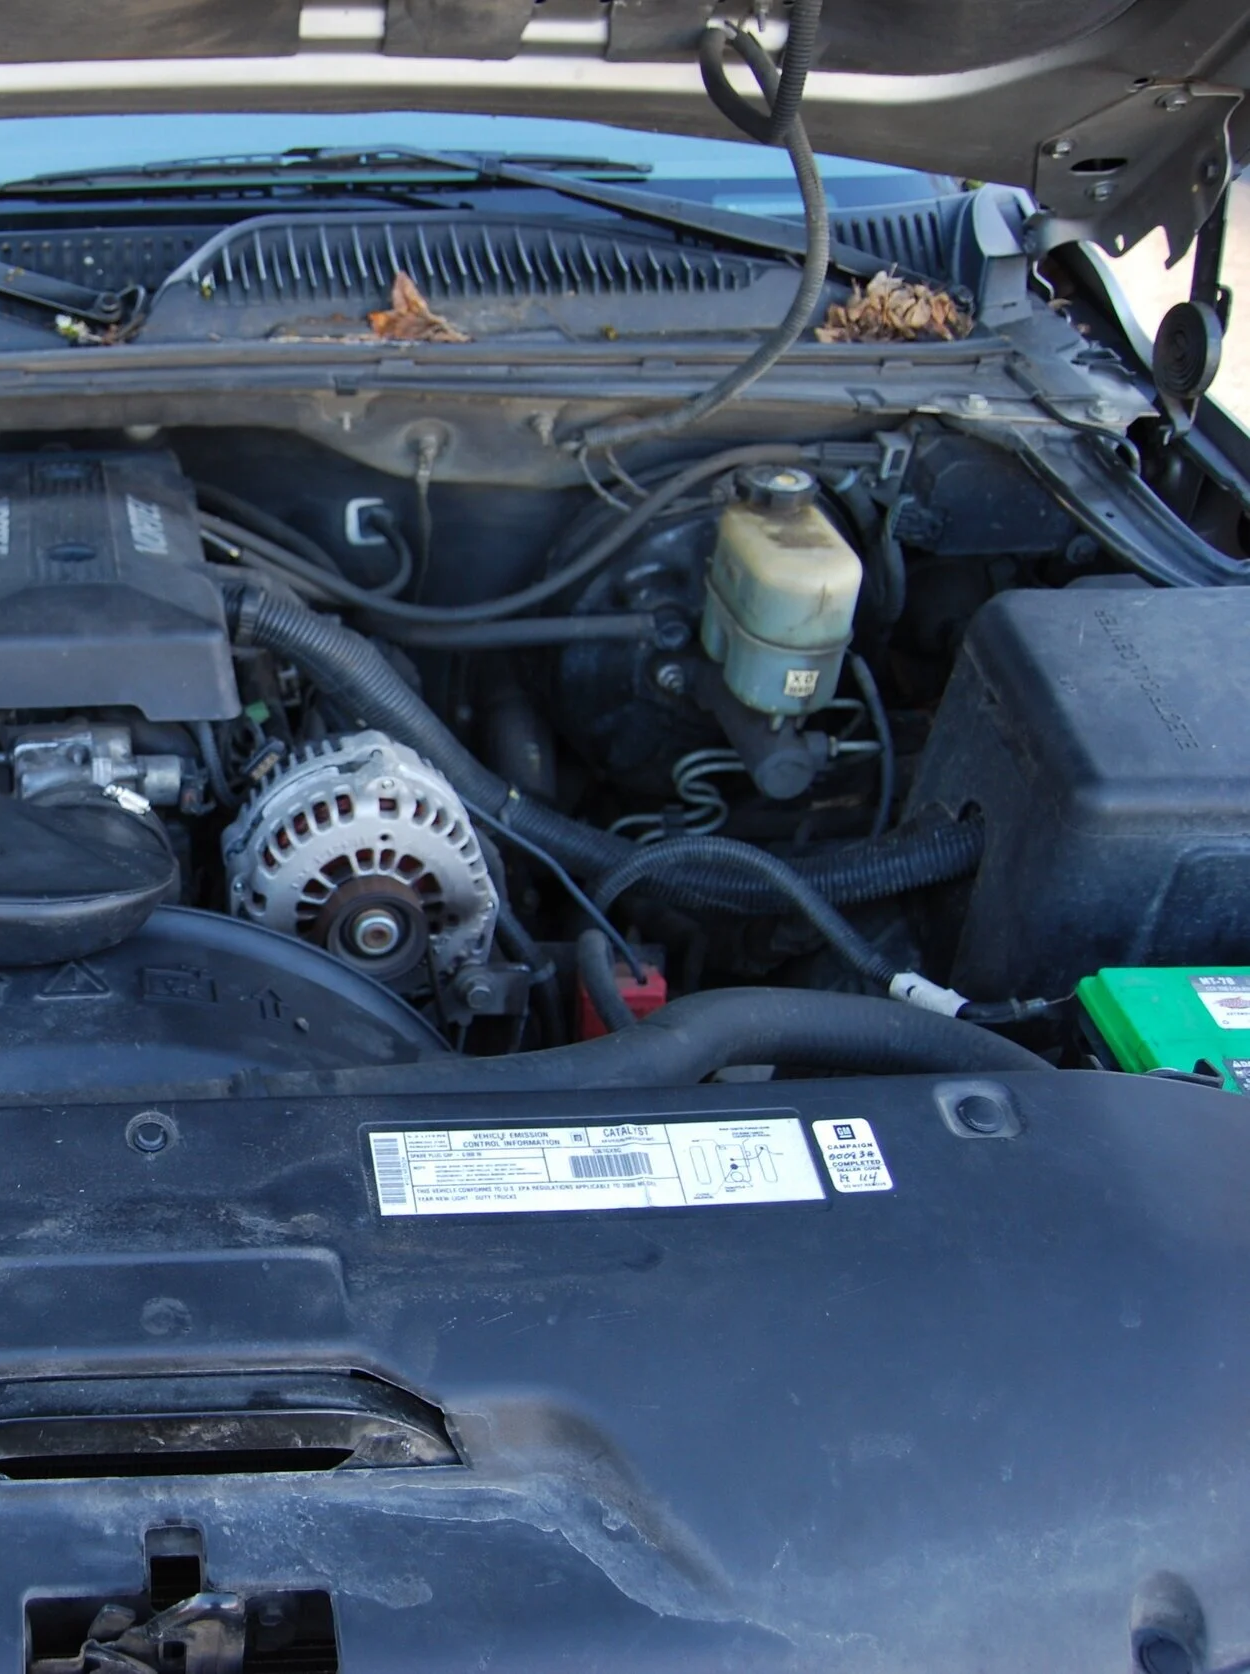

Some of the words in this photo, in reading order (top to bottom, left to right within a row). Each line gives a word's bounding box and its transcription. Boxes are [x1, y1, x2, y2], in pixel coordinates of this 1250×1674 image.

[472, 1132, 507, 1141] VEHICLE
[509, 1131, 549, 1140] EMISSION
[602, 1127, 649, 1138] CATALYST
[836, 1126, 852, 1137] GM
[462, 1140, 501, 1148] CONTROL
[503, 1138, 561, 1148] INFORMATION
[827, 1142, 873, 1150] CAMPAIGN
[832, 1160, 882, 1168] COMPLETED
